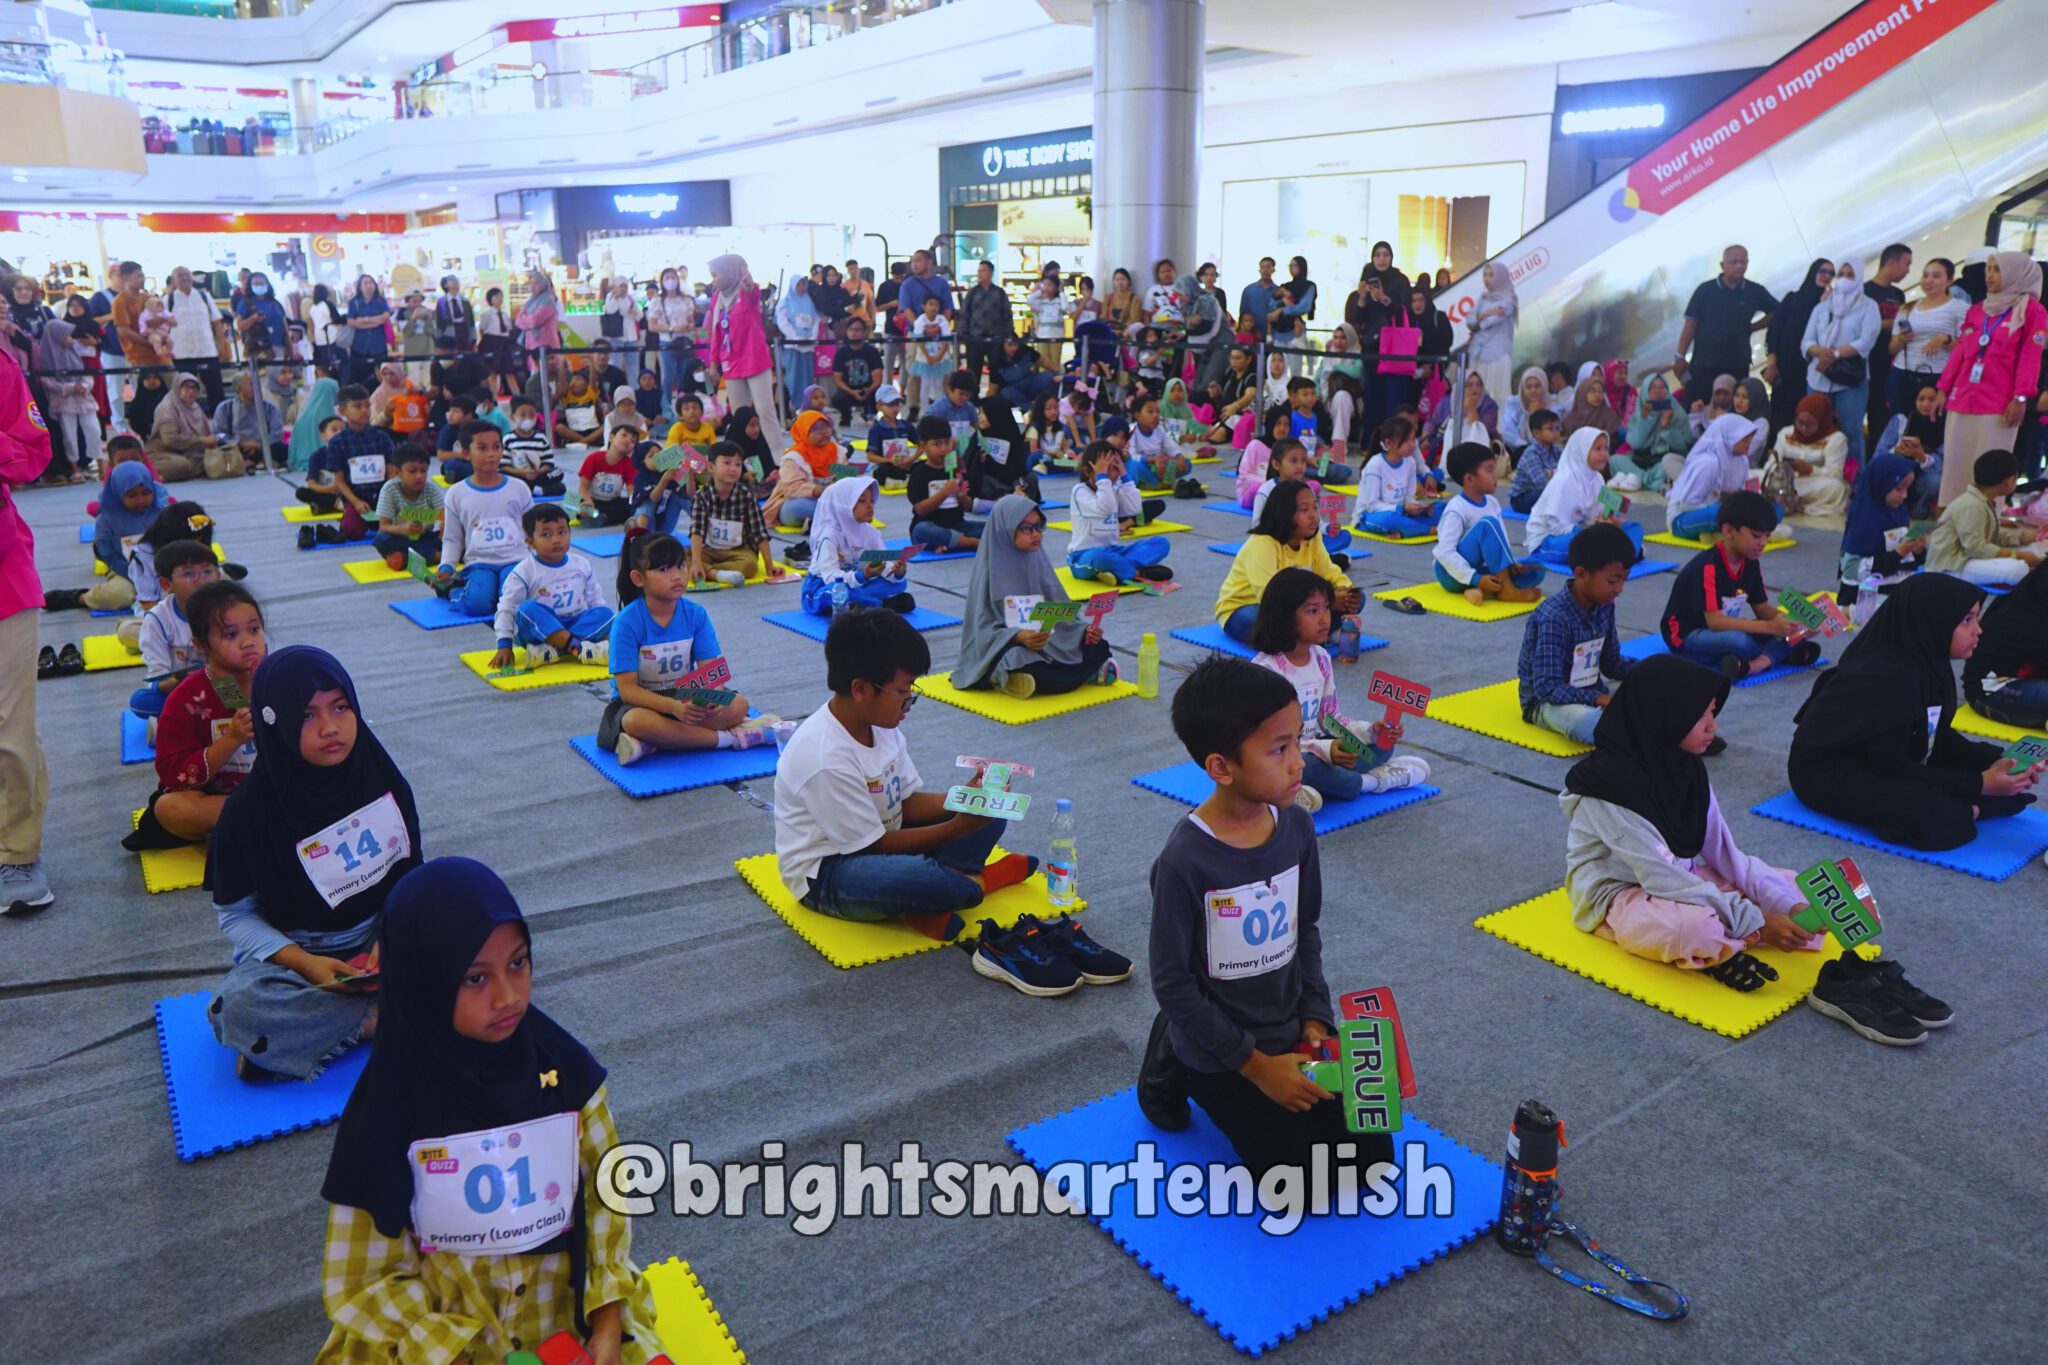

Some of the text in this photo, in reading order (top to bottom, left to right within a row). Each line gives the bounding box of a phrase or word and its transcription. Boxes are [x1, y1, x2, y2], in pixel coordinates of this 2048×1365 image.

[1650, 150, 1689, 183] Your
[1690, 116, 1741, 159] Home
[1740, 94, 1778, 126] Life
[1777, 3, 1912, 102] Improvement
[1525, 252, 1542, 272] UG
[484, 526, 506, 542] 30
[712, 527, 730, 542] 31
[552, 590, 574, 609] 27
[1036, 607, 1077, 618] TRUE
[1784, 592, 1820, 626] TRUE
[657, 653, 685, 675] 16
[1301, 698, 1320, 722] 12
[1372, 679, 1428, 710] FALSE
[886, 775, 901, 810] 13
[952, 791, 1021, 813] TRUE
[334, 828, 383, 873] 14
[328, 879, 360, 900] Primary
[360, 863, 386, 884] (Lower
[1807, 865, 1871, 943] TRUE
[1242, 900, 1288, 947] 02
[1218, 958, 1260, 971] Primary
[1261, 949, 1286, 967] (Lower
[1350, 1021, 1390, 1131] TRUE
[464, 1154, 537, 1215] 01
[430, 1207, 566, 1245] Primary (Lower Class)
